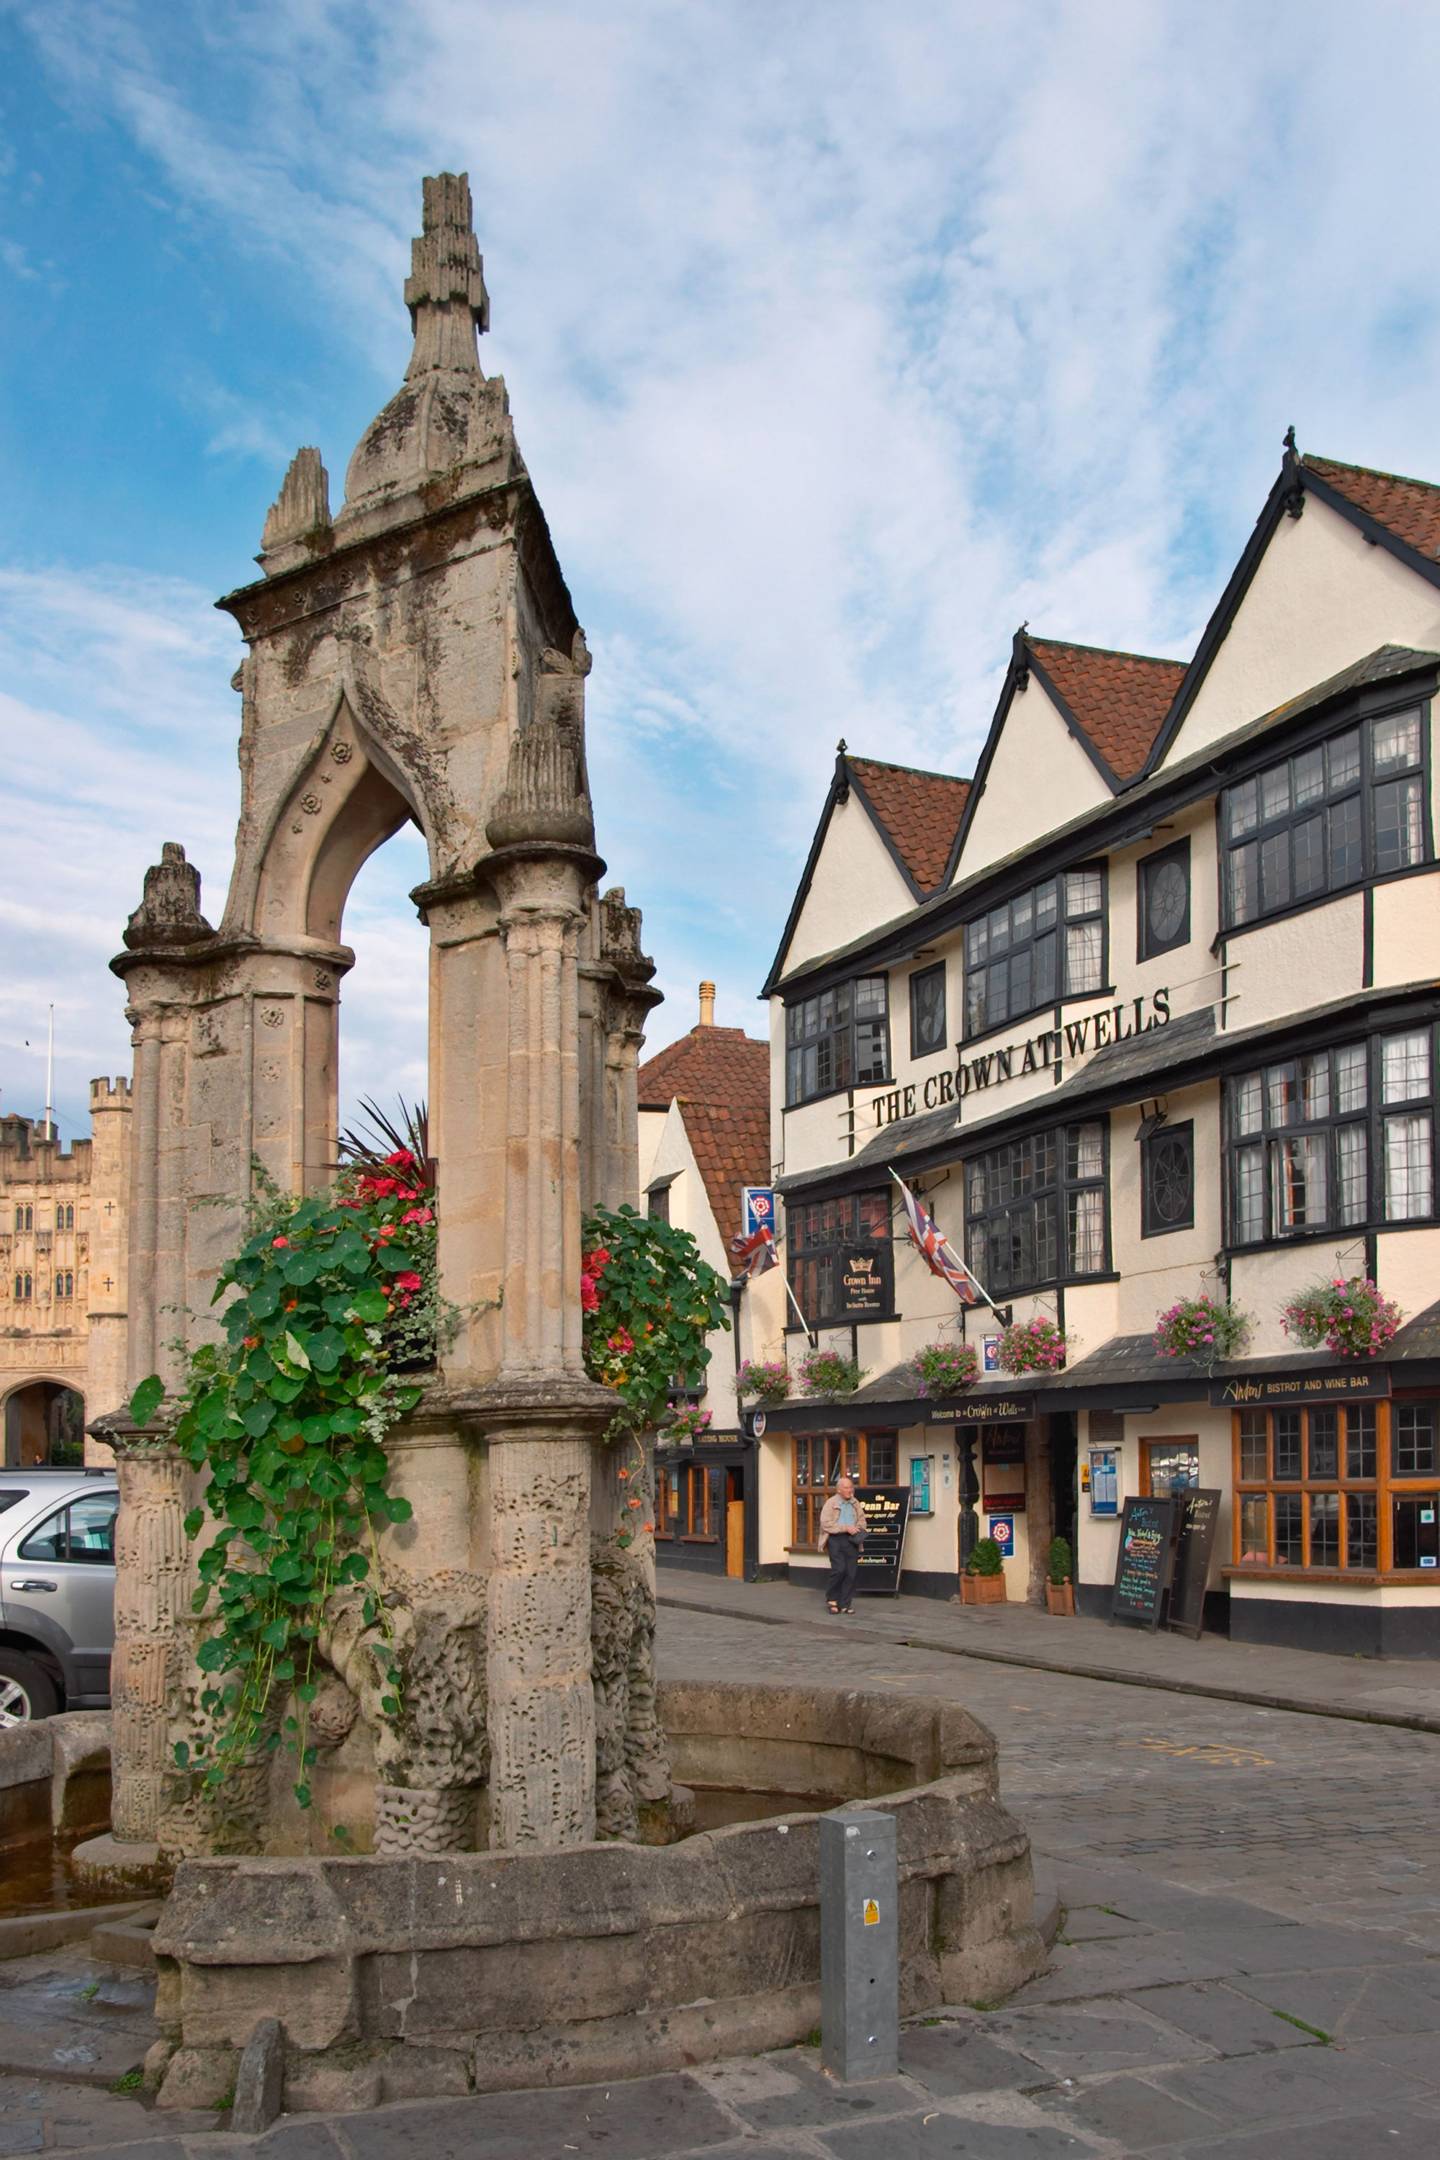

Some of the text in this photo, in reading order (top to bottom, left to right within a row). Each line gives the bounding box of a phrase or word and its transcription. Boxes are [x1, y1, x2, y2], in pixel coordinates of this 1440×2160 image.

[873, 987, 1170, 1127] THE CROWN AT WELLS
[843, 1274, 881, 1286] Crown Inn
[1267, 1381, 1301, 1394] BISTROT
[1304, 1379, 1322, 1391] AND
[1325, 1377, 1347, 1390] WINE
[1350, 1375, 1369, 1388] BAR
[931, 1410, 955, 1420] Welcome
[955, 1409, 962, 1418] to
[860, 1500, 900, 1511] Penn Bar
